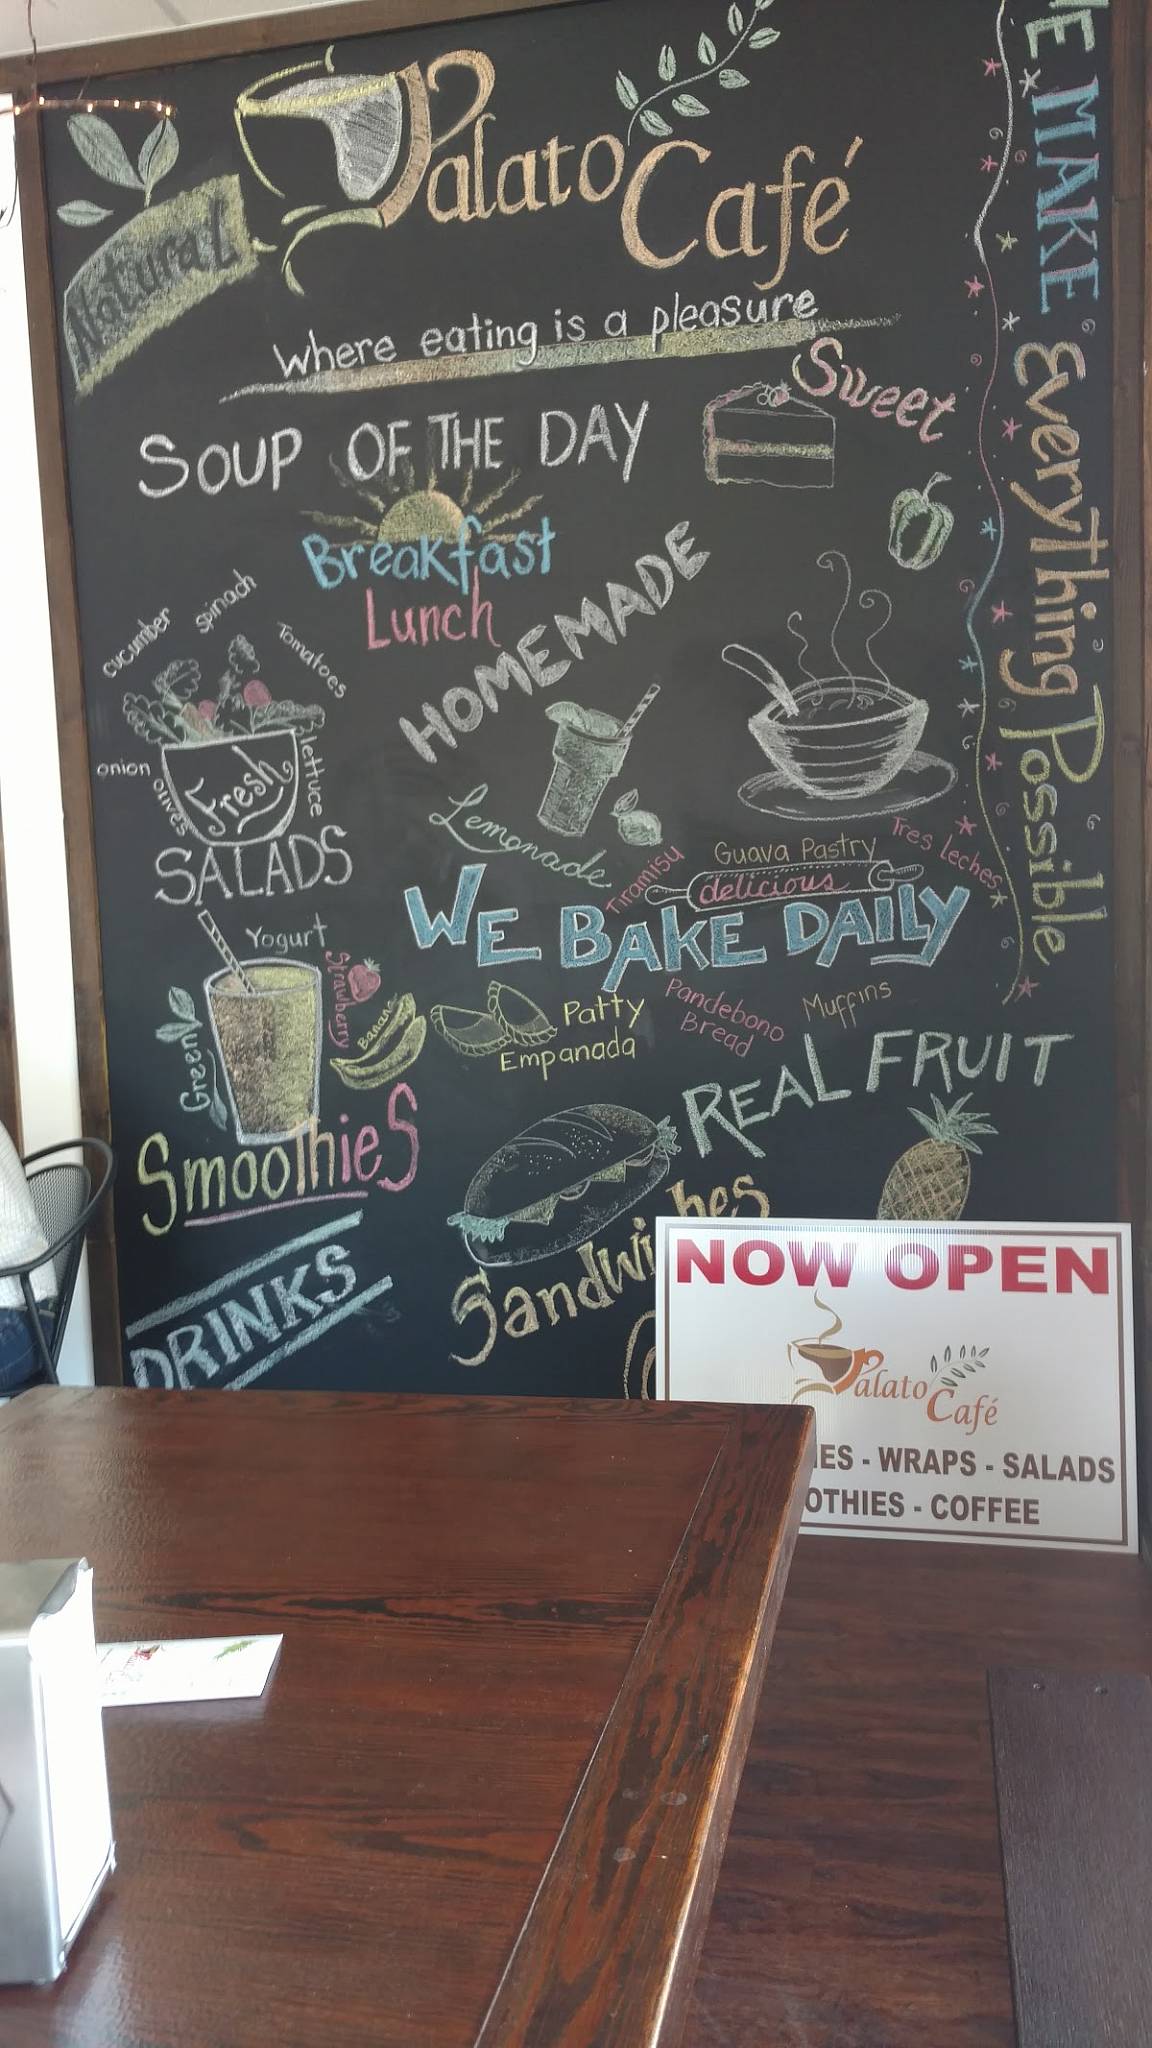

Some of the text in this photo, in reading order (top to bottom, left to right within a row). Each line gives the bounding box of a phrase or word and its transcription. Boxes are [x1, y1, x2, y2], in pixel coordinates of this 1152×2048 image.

[379, 49, 863, 290] Palato Café
[68, 195, 241, 376] Natural
[273, 289, 818, 378] Where eating is a pleasure
[792, 337, 956, 444] Sweet
[138, 400, 650, 499] SOUP OF THE DAY
[1000, 0, 1110, 966] E MAKE Everything Possible
[303, 515, 556, 595] Breakfast
[103, 607, 170, 678] cucumber
[366, 564, 502, 650] Lunch
[399, 520, 712, 765] HOMEMADE
[277, 621, 346, 698] Tomatoes
[97, 757, 151, 777] onion
[300, 735, 326, 818] lettuce
[155, 824, 353, 906] SALADS
[428, 783, 612, 888] Lemonade
[714, 832, 877, 866] Guava Pastry
[893, 815, 934, 851] Tres
[605, 845, 686, 914] Tiramisu
[698, 870, 850, 905] delicious
[245, 912, 328, 954] Yogurt
[403, 862, 970, 992] WE BAKE DAILY
[325, 951, 356, 1049] Strawberry
[563, 991, 645, 1030] Patty
[665, 977, 785, 1042] Pandebono
[680, 1010, 754, 1058] Bread
[802, 977, 892, 1029] Muffins
[180, 1032, 211, 1112] Green
[499, 1032, 636, 1080] Empanada
[682, 1029, 1075, 1159] REAL FRUIT
[450, 1174, 770, 1367] Sandwihes
[676, 1238, 1110, 1295] NOW OPEN
[130, 1244, 356, 1390] DRINKS
[926, 1388, 1000, 1436] Café
[878, 1446, 976, 1477] WRAPS
[1002, 1452, 1116, 1484] SALADS
[804, 1487, 905, 1518] OTHIES
[930, 1493, 1040, 1525] COFFEE
